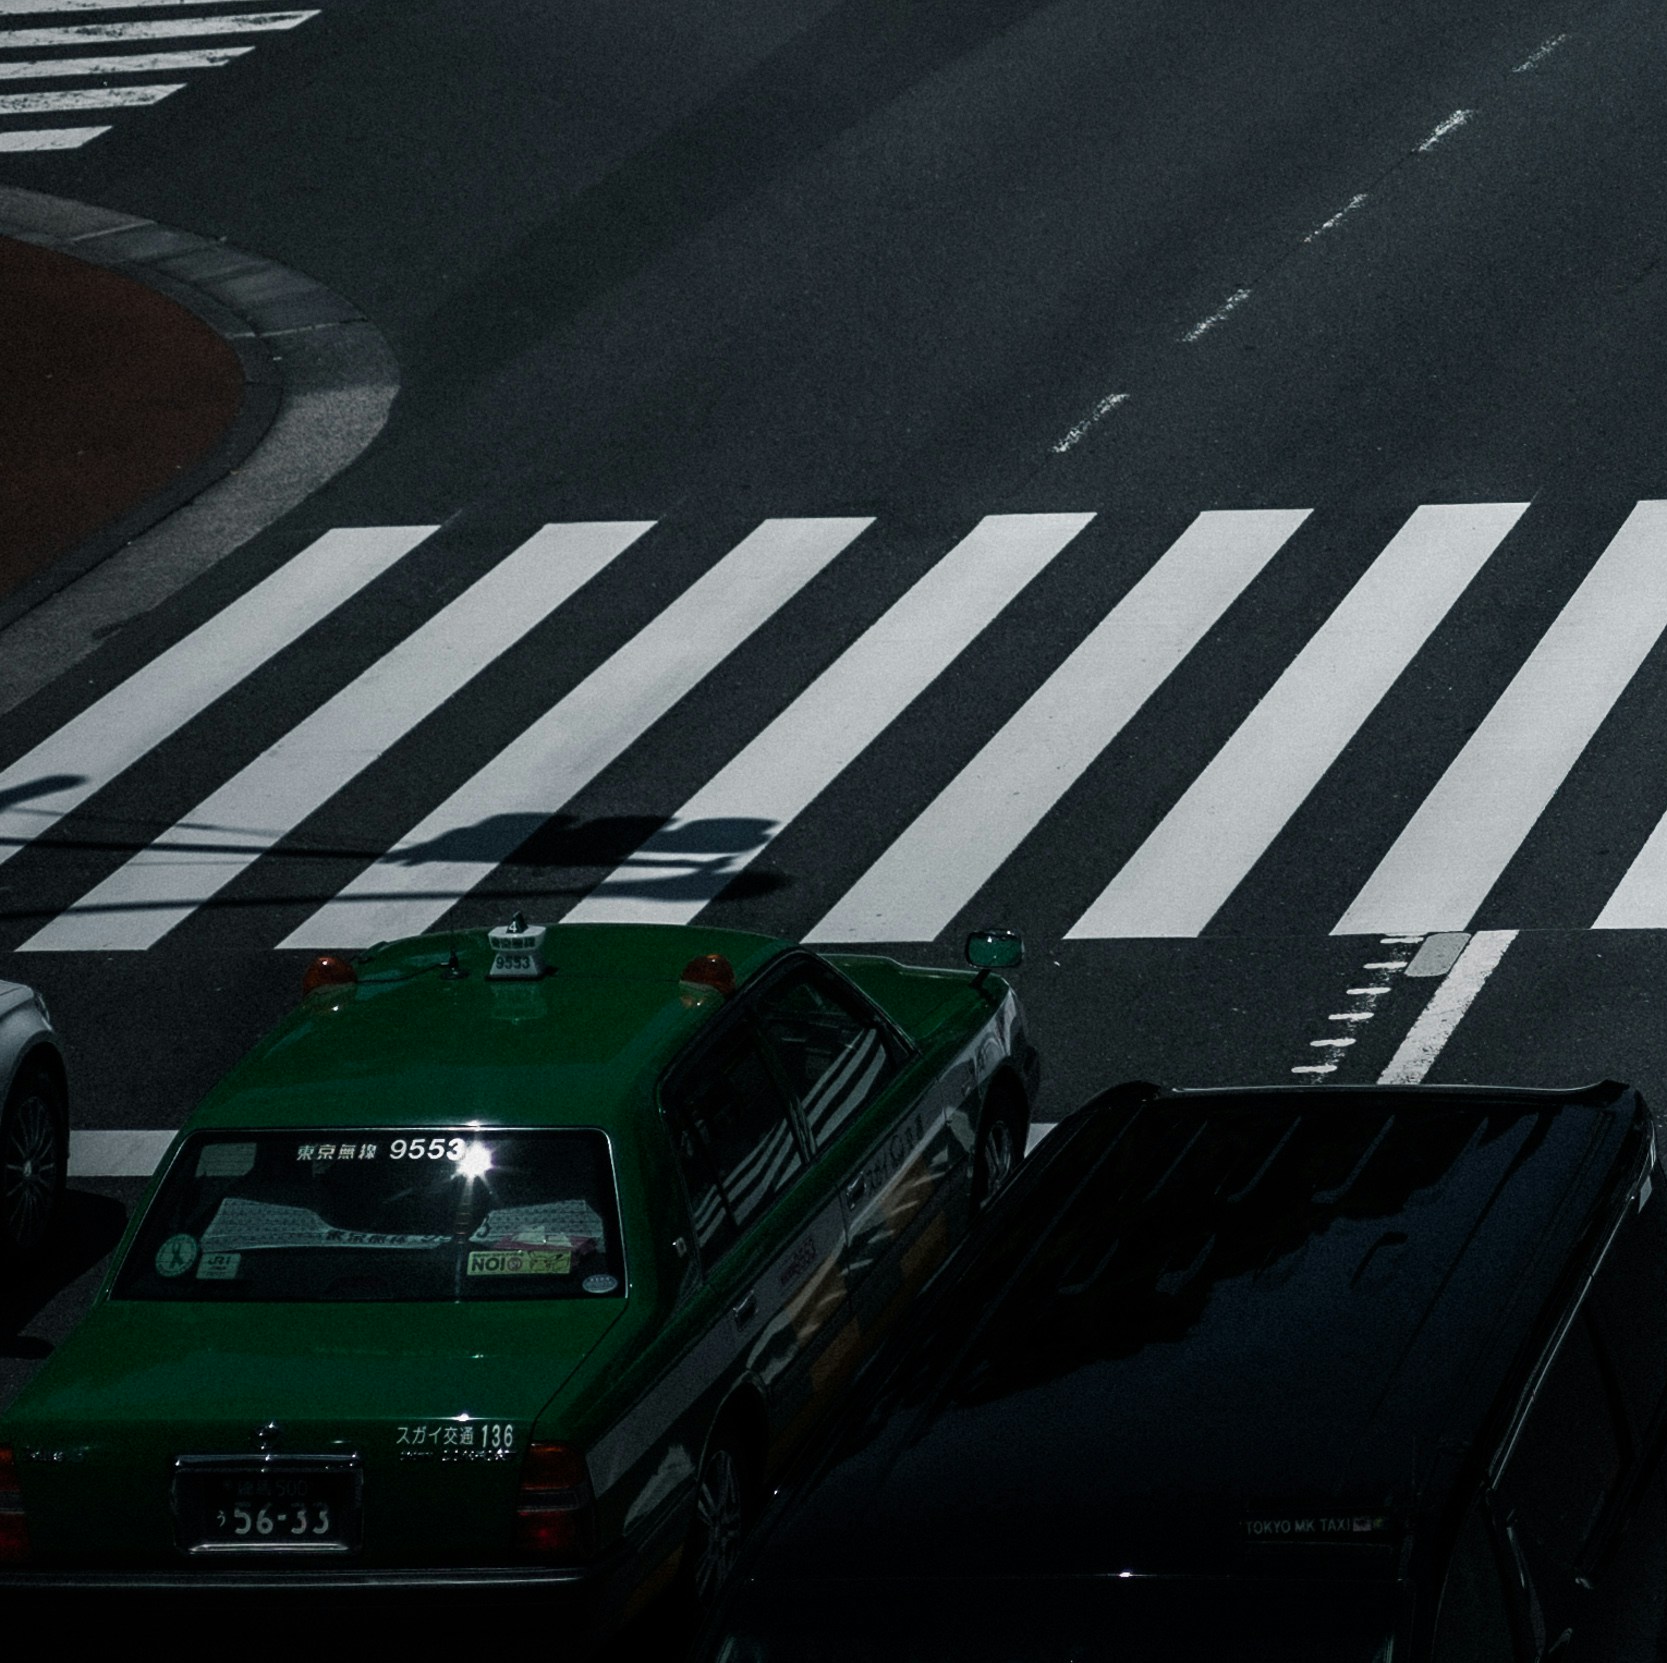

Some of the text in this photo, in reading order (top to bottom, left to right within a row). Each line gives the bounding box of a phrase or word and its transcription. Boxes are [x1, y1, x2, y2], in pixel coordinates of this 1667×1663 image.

[496, 956, 531, 969] 9553
[296, 1137, 466, 1161] 東京無線 9553
[396, 1424, 514, 1448] スガイ交通 136
[275, 1479, 307, 1497] 500
[234, 1502, 329, 1535] 56-33
[1246, 1518, 1350, 1535] TOKYO MK TAXI
